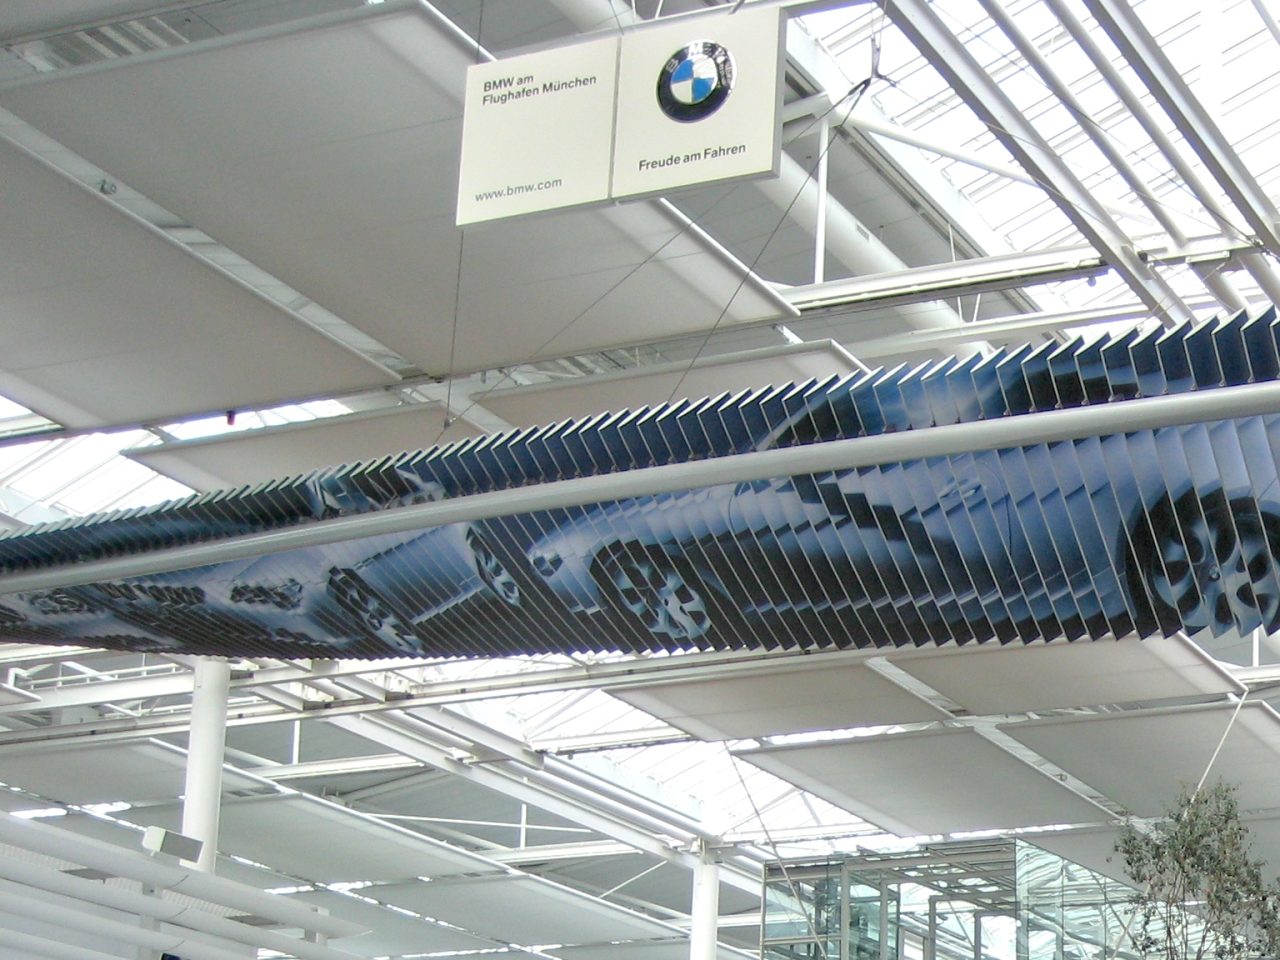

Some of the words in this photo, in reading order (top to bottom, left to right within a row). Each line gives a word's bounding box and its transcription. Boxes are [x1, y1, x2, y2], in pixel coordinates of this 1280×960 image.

[482, 85, 540, 106] Flughafen
[542, 74, 597, 93] München
[483, 77, 515, 92] BMW
[517, 72, 534, 84] am
[639, 157, 681, 172] Freude
[683, 151, 701, 163] am
[704, 142, 746, 161] Fahren
[475, 177, 562, 202] www.bmw.com
